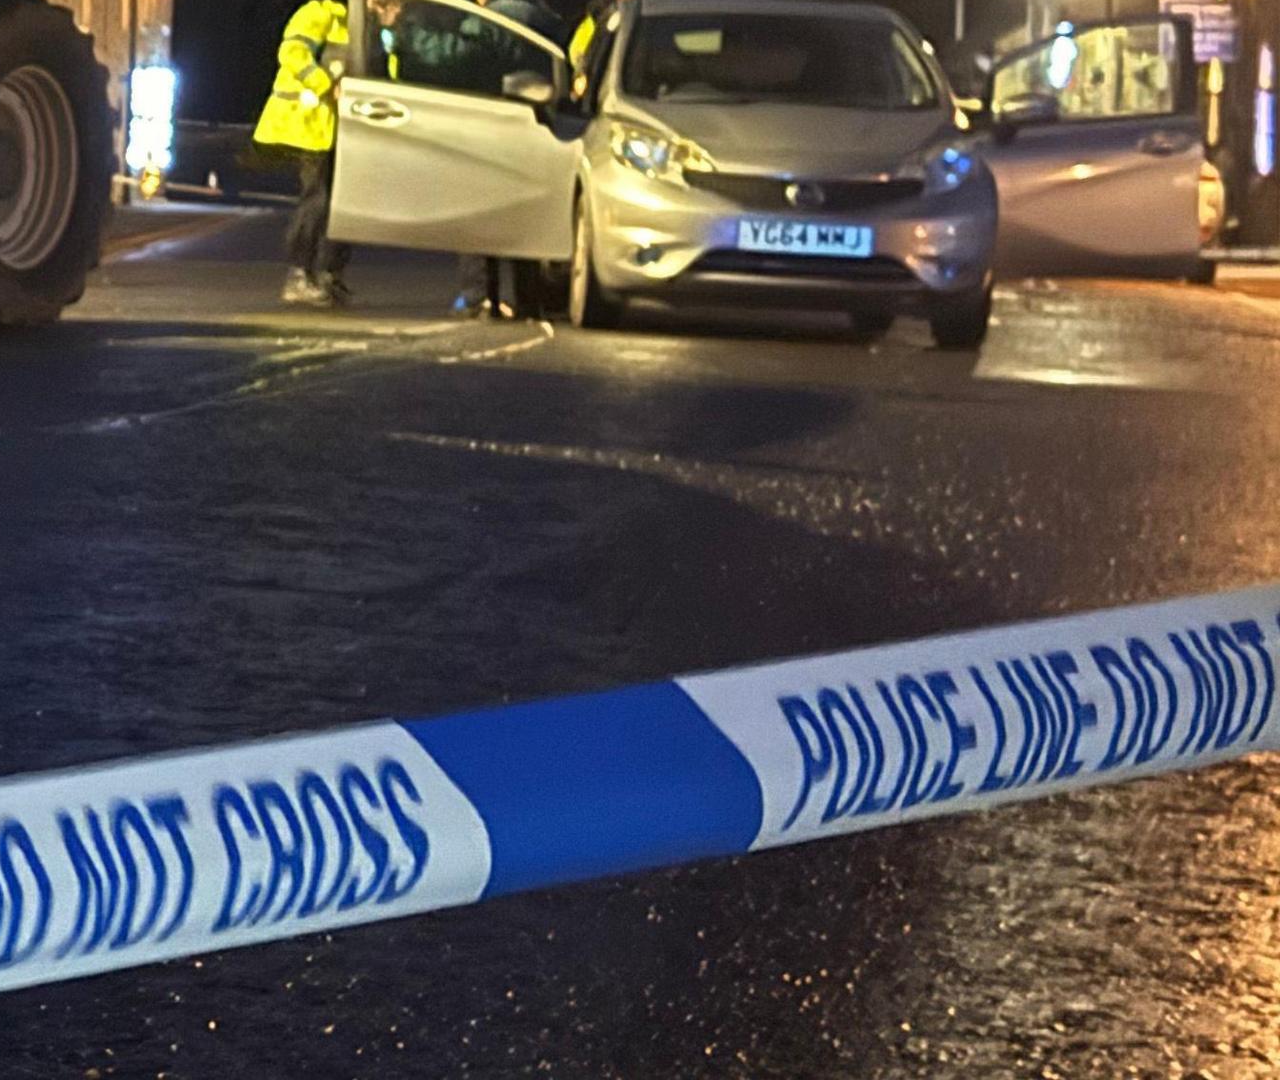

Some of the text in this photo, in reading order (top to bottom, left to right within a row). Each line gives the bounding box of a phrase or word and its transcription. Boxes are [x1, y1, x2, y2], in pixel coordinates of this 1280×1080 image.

[778, 619, 1275, 832] POLICE LINE DO NOT
[54, 791, 195, 960] NOT
[211, 756, 430, 933] CROSS
